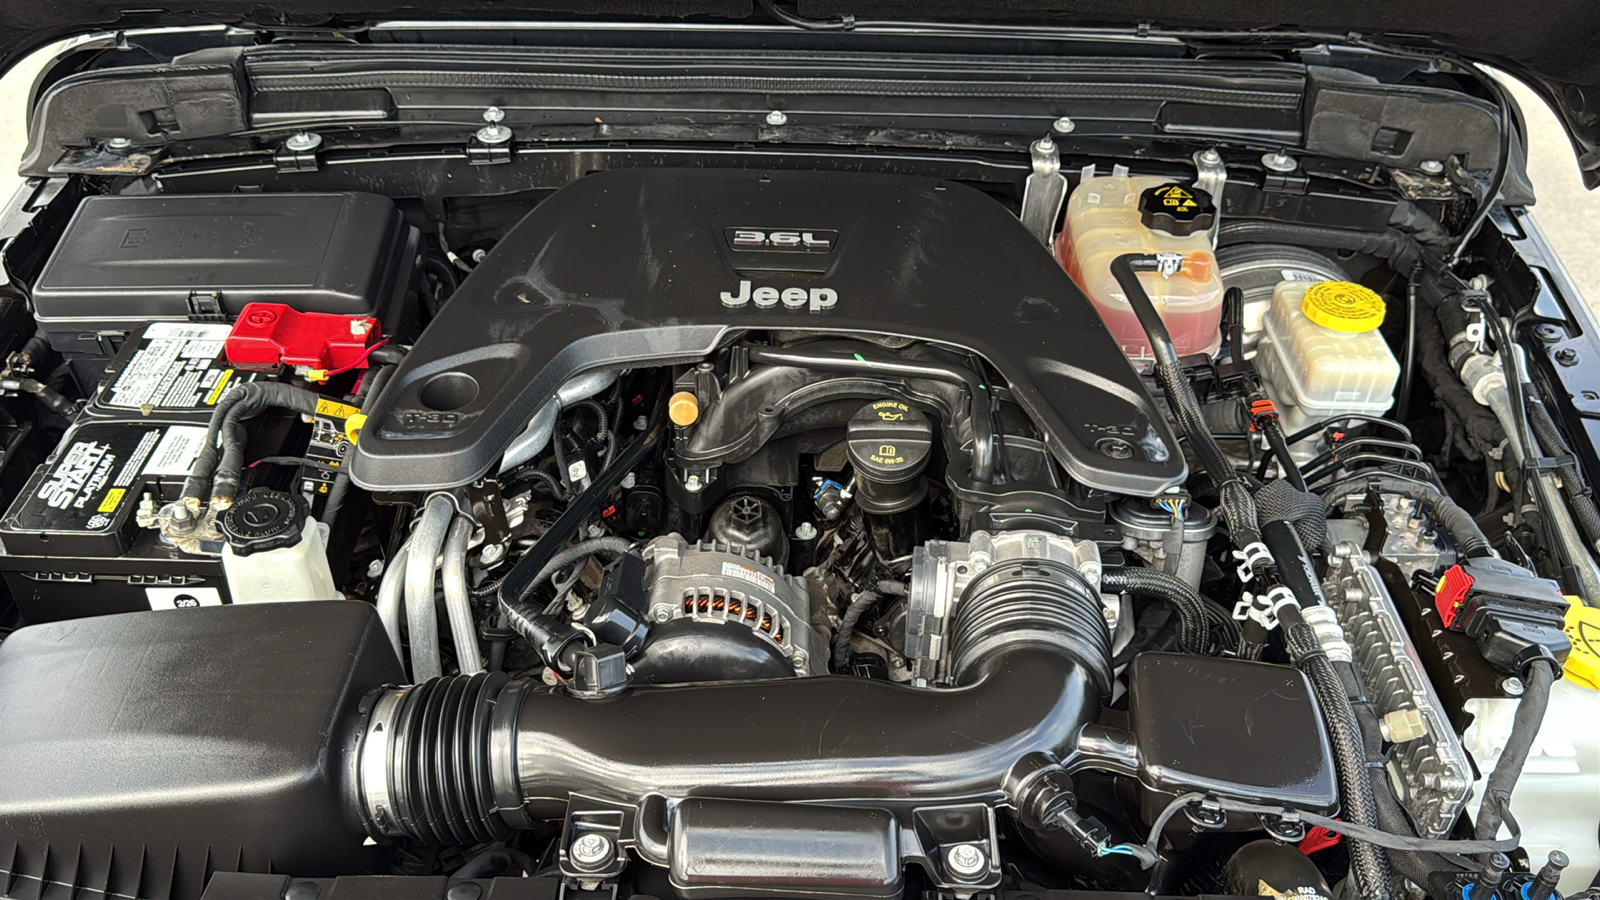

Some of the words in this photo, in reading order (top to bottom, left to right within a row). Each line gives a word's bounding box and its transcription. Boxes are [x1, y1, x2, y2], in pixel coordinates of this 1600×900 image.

[733, 230, 830, 248] 3.6L
[719, 280, 839, 314] Jeep
[872, 401, 898, 410] ENGINE
[898, 403, 909, 412] OIL
[870, 454, 884, 464] SAE
[37, 441, 92, 499] SUPER
[47, 441, 105, 510] START
[73, 453, 117, 509] PLATINUM
[176, 599, 198, 608] 2/26
[1297, 886, 1316, 895] RAD
